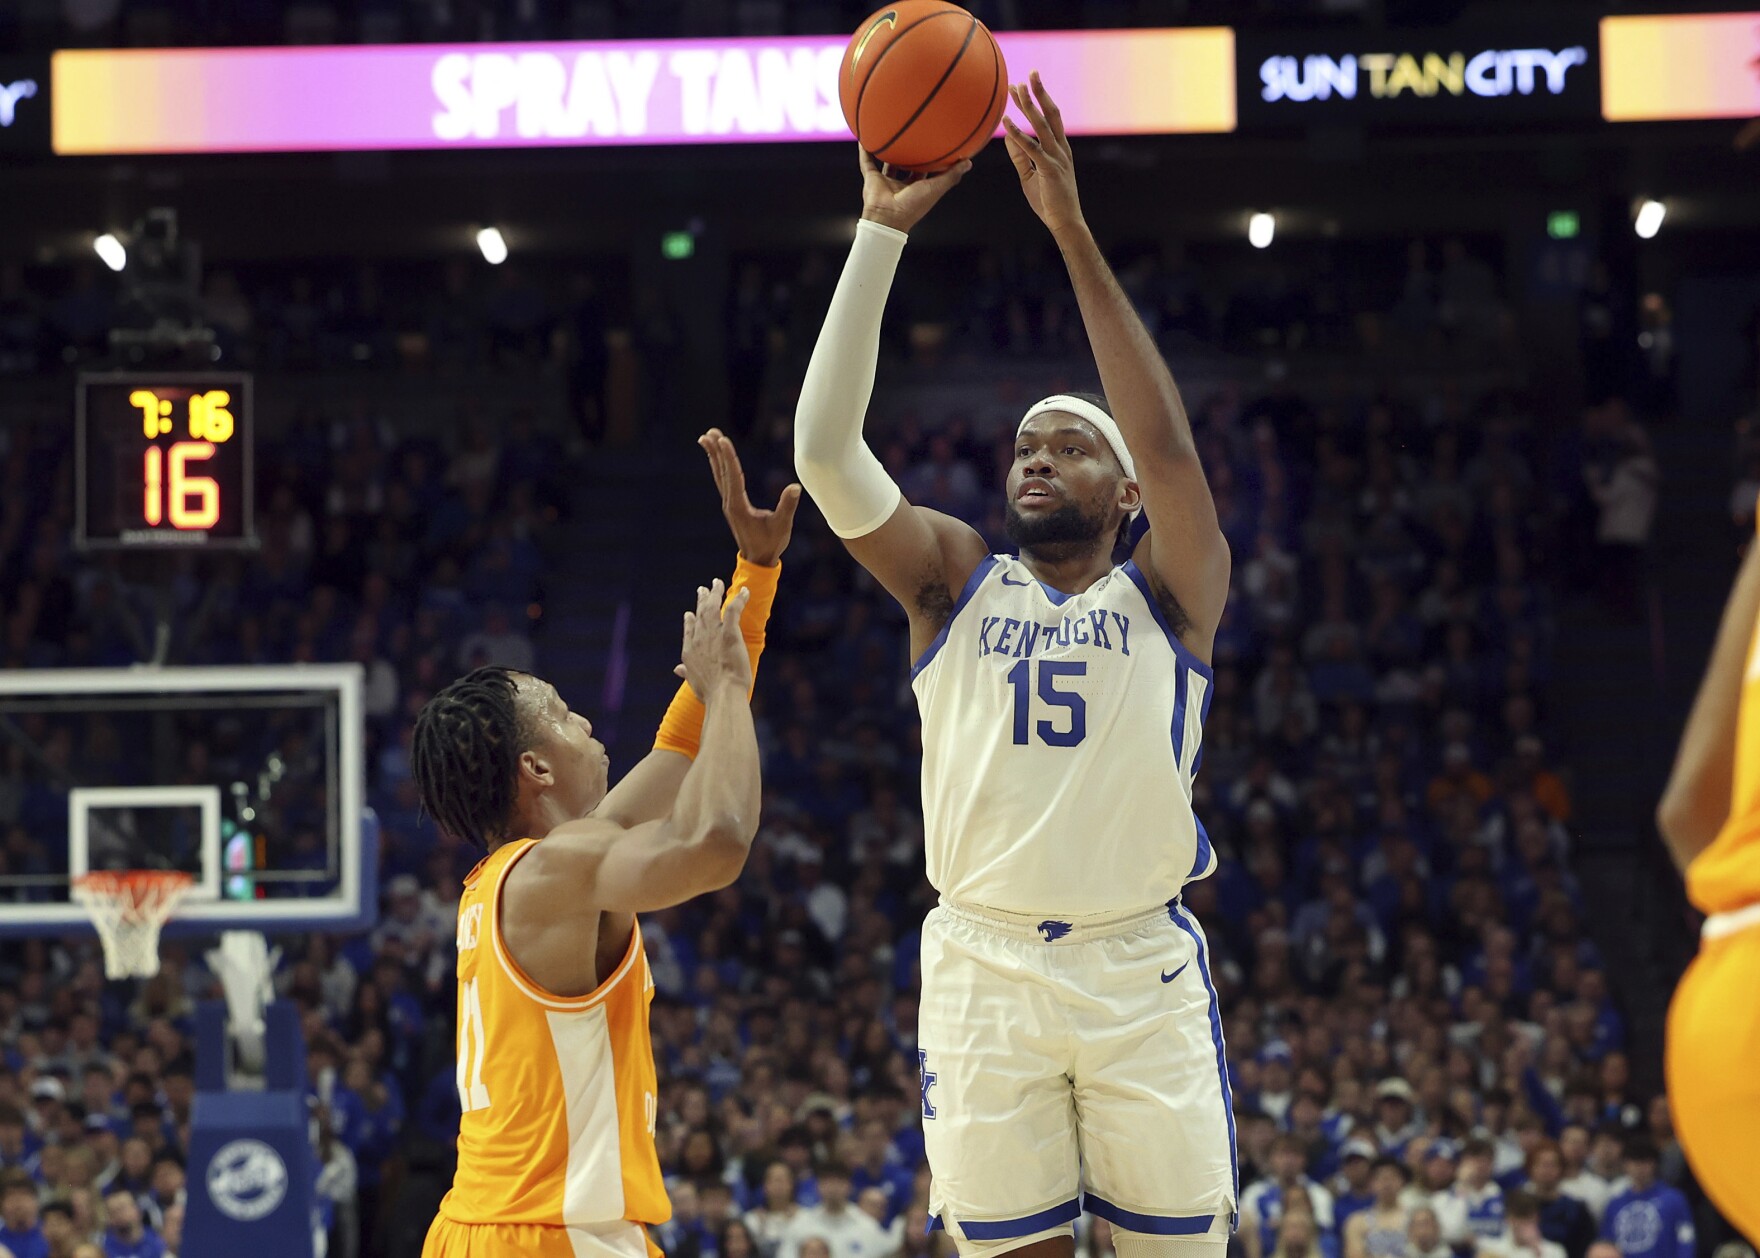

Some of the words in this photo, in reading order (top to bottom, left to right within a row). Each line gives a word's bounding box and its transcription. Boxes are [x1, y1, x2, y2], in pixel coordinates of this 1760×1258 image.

[431, 51, 660, 140] SPRAY
[1259, 53, 1357, 102] SUN
[144, 441, 220, 529] 16
[979, 608, 1130, 658] KENTUCKY
[1007, 659, 1087, 748] 15
